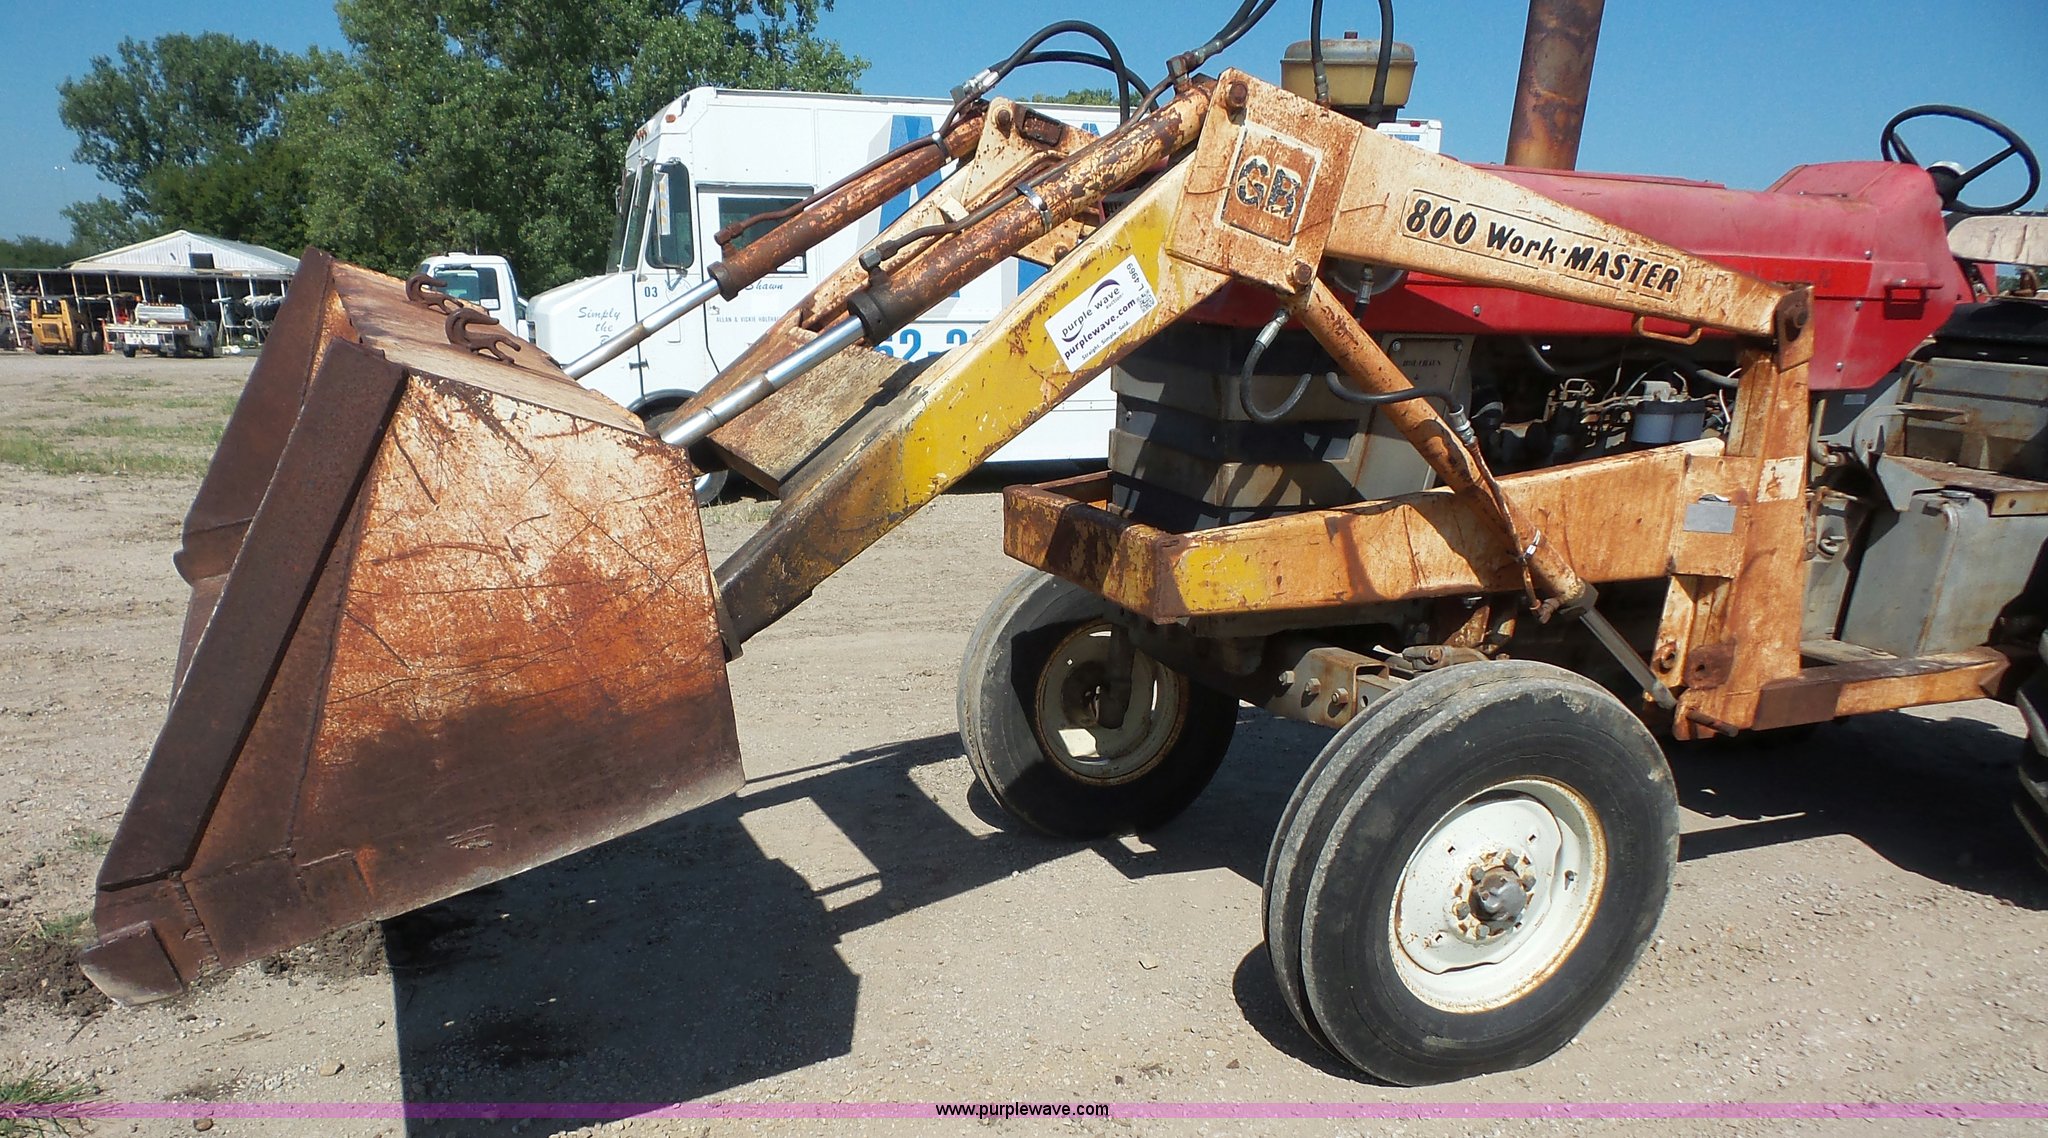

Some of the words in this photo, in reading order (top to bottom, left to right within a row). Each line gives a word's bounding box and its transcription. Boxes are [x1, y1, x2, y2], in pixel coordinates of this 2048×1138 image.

[1405, 198, 1478, 245] 800
[1126, 262, 1140, 284] 4969
[644, 286, 659, 298] 03
[1138, 283, 1144, 292] L
[578, 306, 621, 321] Simply
[1062, 308, 1093, 337] purple
[1094, 287, 1120, 310] wave
[595, 321, 614, 332] the
[1064, 298, 1136, 360] purplewave.com
